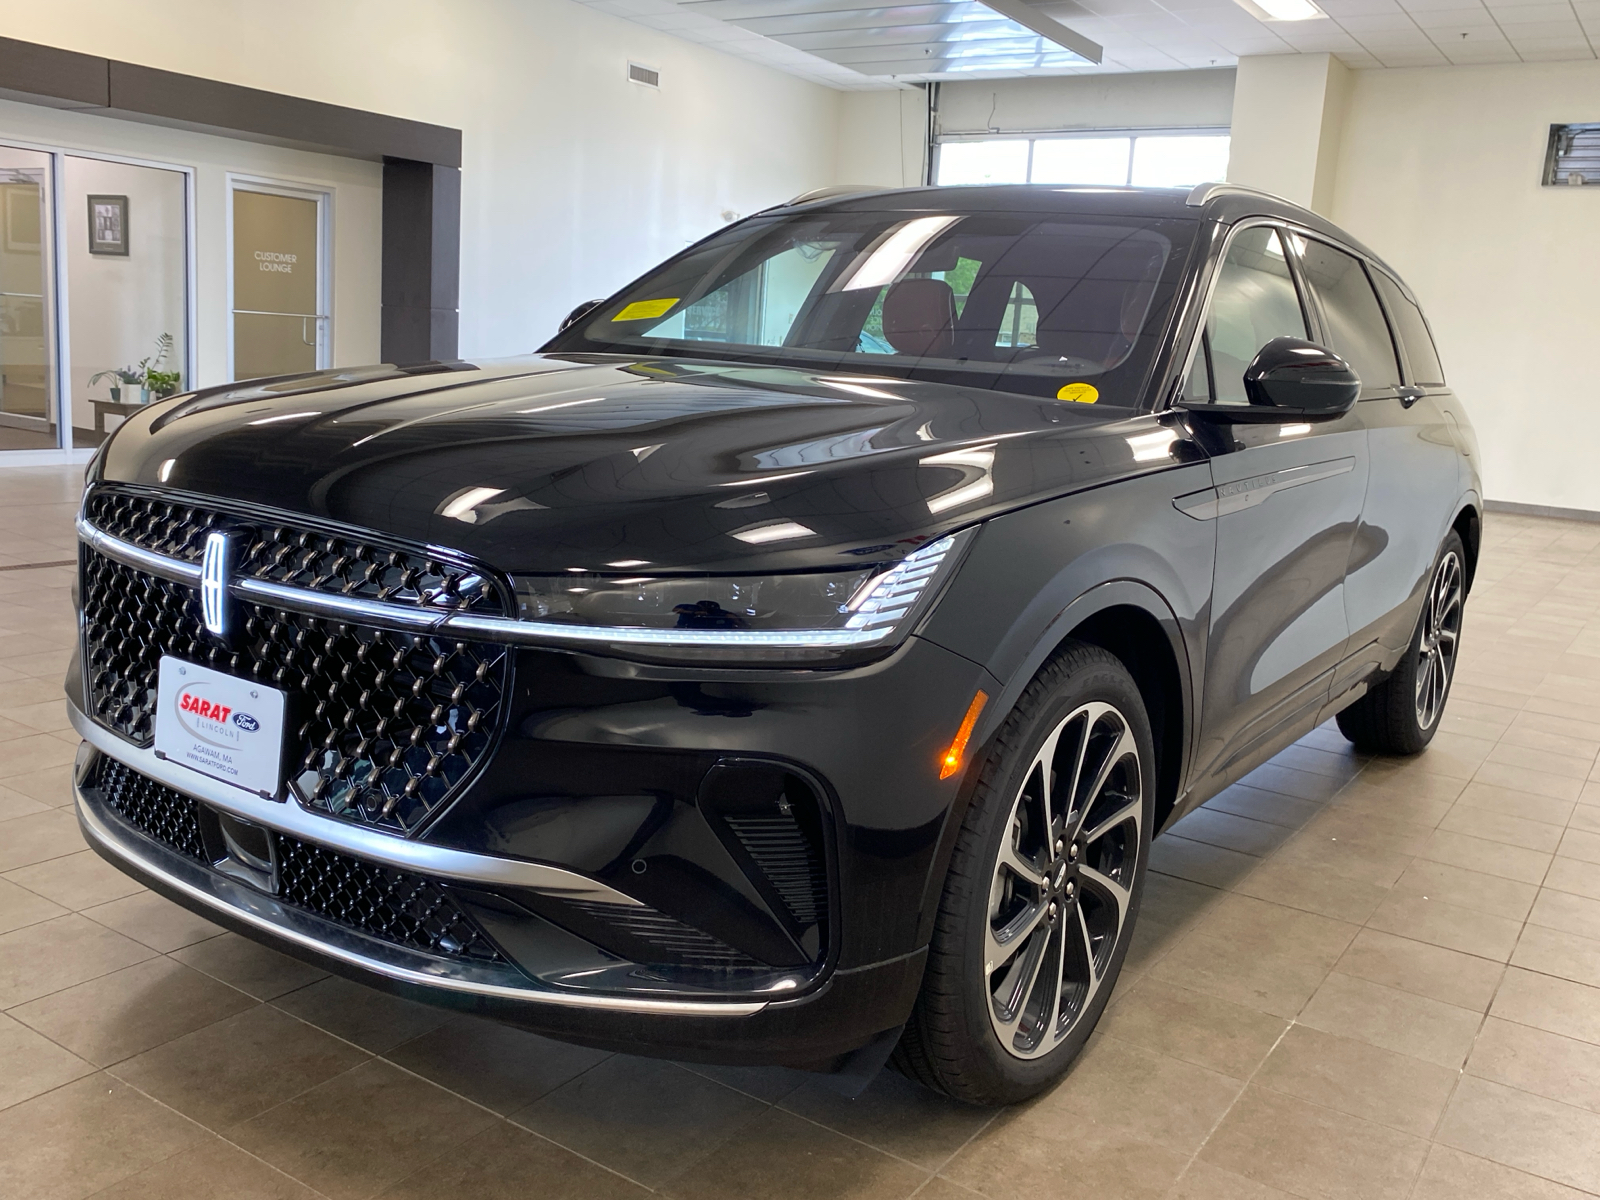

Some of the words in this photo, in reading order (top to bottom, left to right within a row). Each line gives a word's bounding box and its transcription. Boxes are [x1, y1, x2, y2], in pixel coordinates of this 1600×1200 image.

[254, 251, 297, 263] CUSTOMER
[259, 262, 292, 273] LOUNGE
[180, 693, 232, 724] SARAT
[202, 721, 234, 737] LINCOLN
[186, 752, 238, 775] WWW.SARATFORD.COM
[193, 744, 221, 760] AGAWAM,
[222, 753, 233, 765] MA
